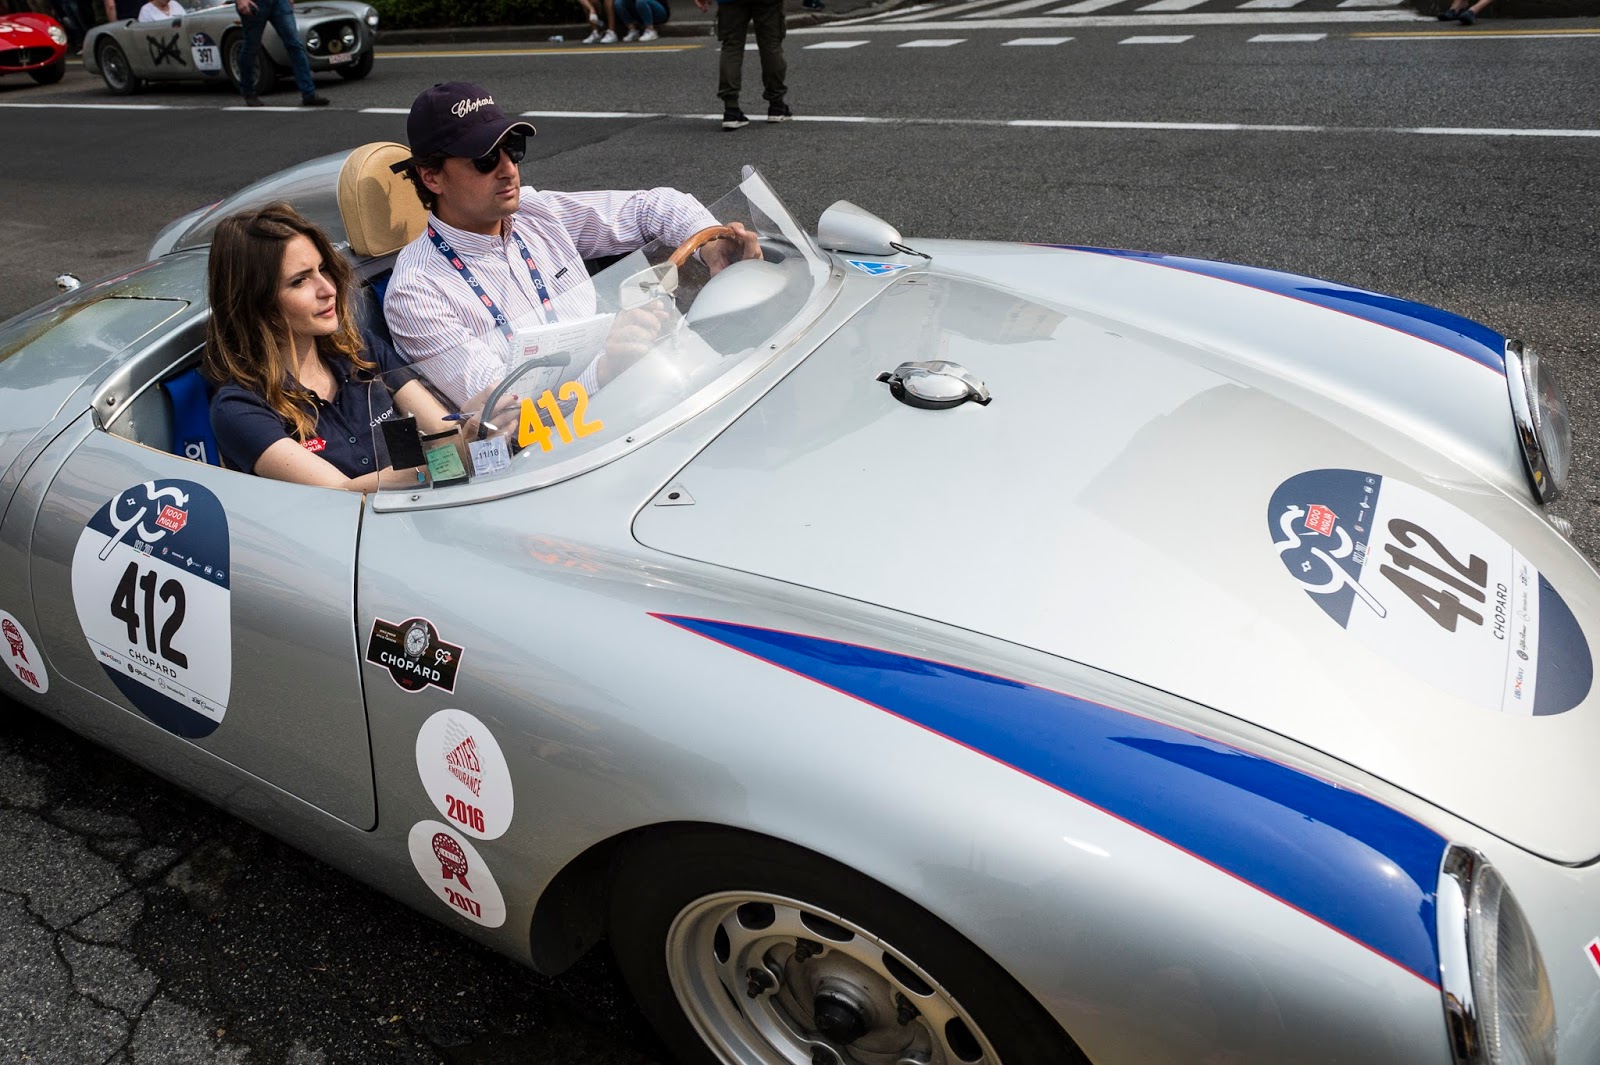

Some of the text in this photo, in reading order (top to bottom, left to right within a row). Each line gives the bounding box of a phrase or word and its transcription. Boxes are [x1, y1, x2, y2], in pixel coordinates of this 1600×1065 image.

[197, 48, 213, 63] 397
[451, 95, 495, 118] Chopard
[517, 381, 604, 453] 412
[479, 448, 500, 460] 11/18
[158, 516, 179, 530] MIGLIA
[165, 508, 183, 520] 1000
[1309, 509, 1321, 526] 1000
[1320, 513, 1332, 534] MIGLIA
[1379, 518, 1488, 633] 412
[110, 561, 188, 670] 412
[1493, 582, 1508, 640] CHOPARD
[128, 648, 177, 678] CHOPARD
[380, 651, 441, 682] CHOPARD
[448, 764, 482, 797] ENDURANCE
[445, 794, 485, 833] 2016
[444, 886, 481, 918] 2017
